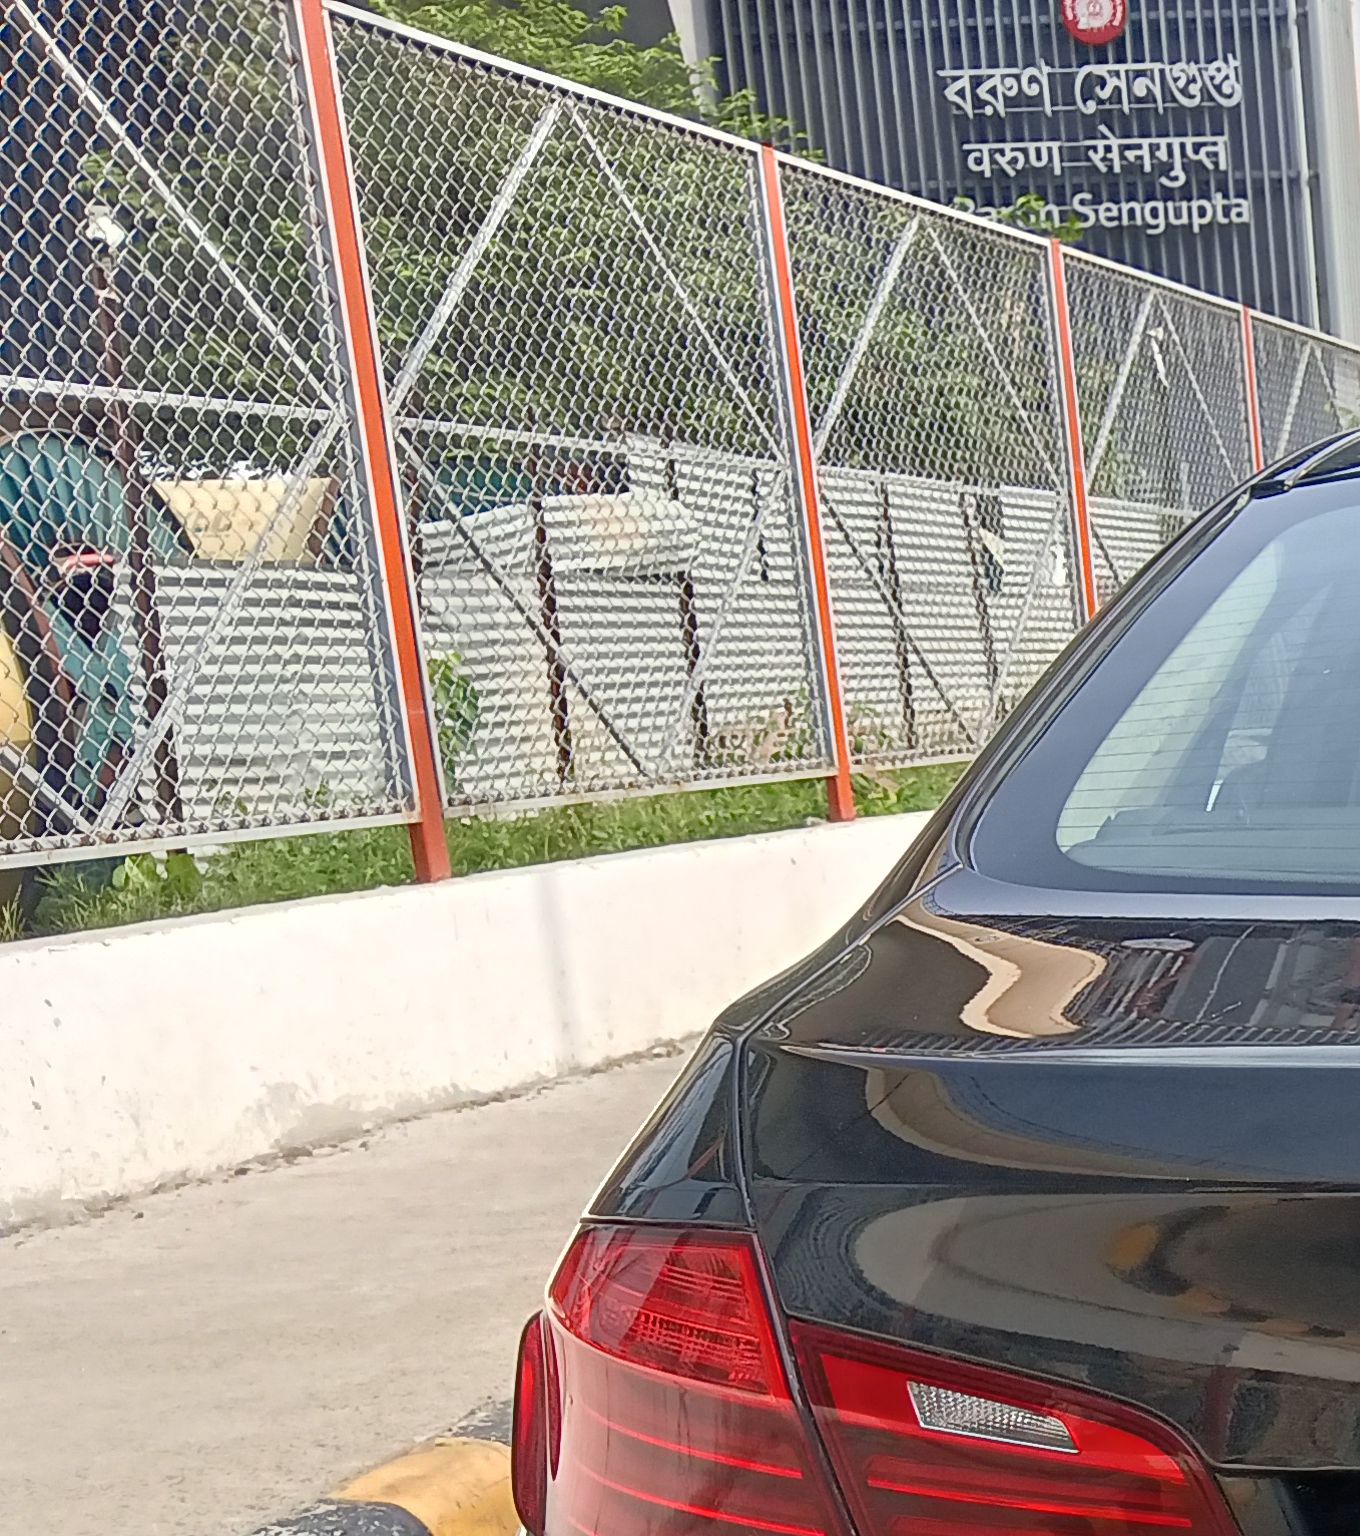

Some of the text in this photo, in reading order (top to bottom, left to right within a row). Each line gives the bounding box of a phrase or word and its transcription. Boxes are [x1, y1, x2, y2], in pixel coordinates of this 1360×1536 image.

[937, 53, 1242, 119] বরুণ সেনগুপ্ত
[963, 124, 1229, 188] वरुण सेनगुप्त
[1072, 192, 1249, 235] Sengupta
